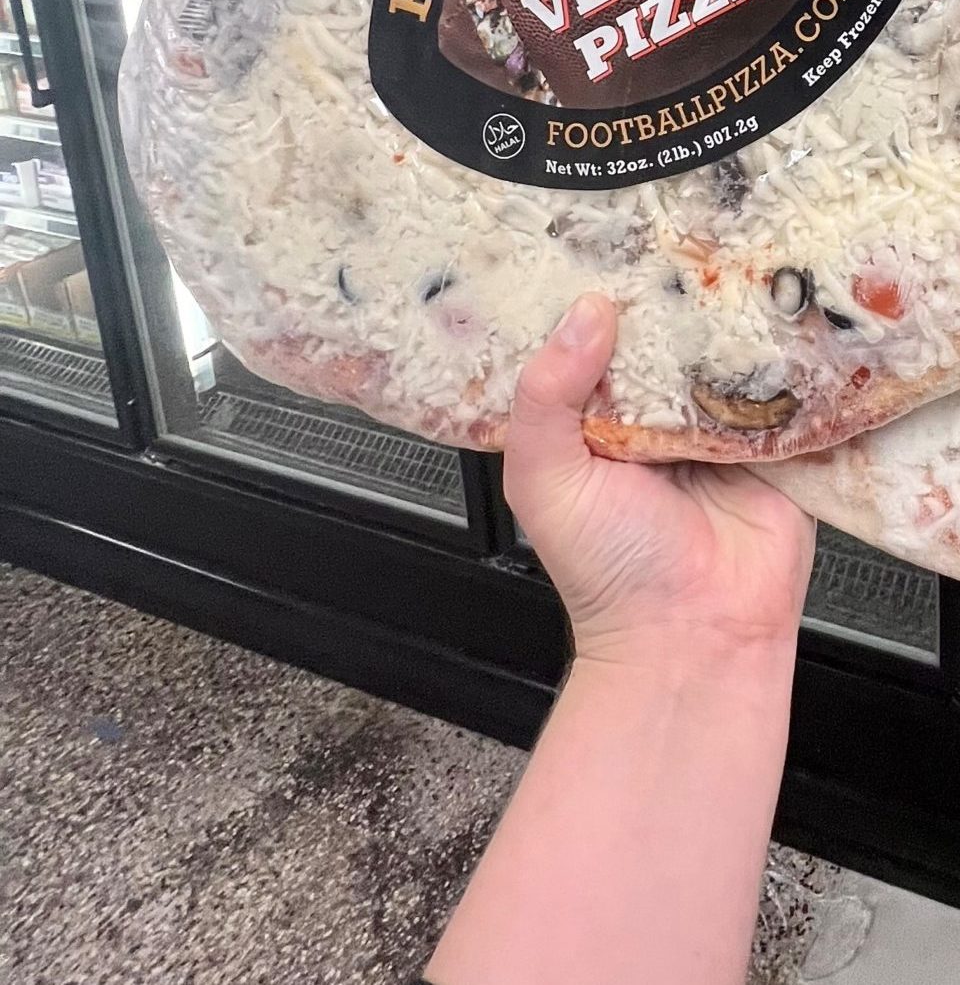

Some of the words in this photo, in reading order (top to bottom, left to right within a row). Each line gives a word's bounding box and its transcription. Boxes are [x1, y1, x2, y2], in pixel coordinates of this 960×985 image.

[801, 48, 842, 87] Keep
[494, 135, 521, 154] HALAL
[544, 159, 572, 175] Net
[574, 163, 602, 177] Wt:
[606, 159, 654, 175] 32oz.
[657, 140, 704, 168] (2lb.)
[703, 114, 759, 150] 907.2g
